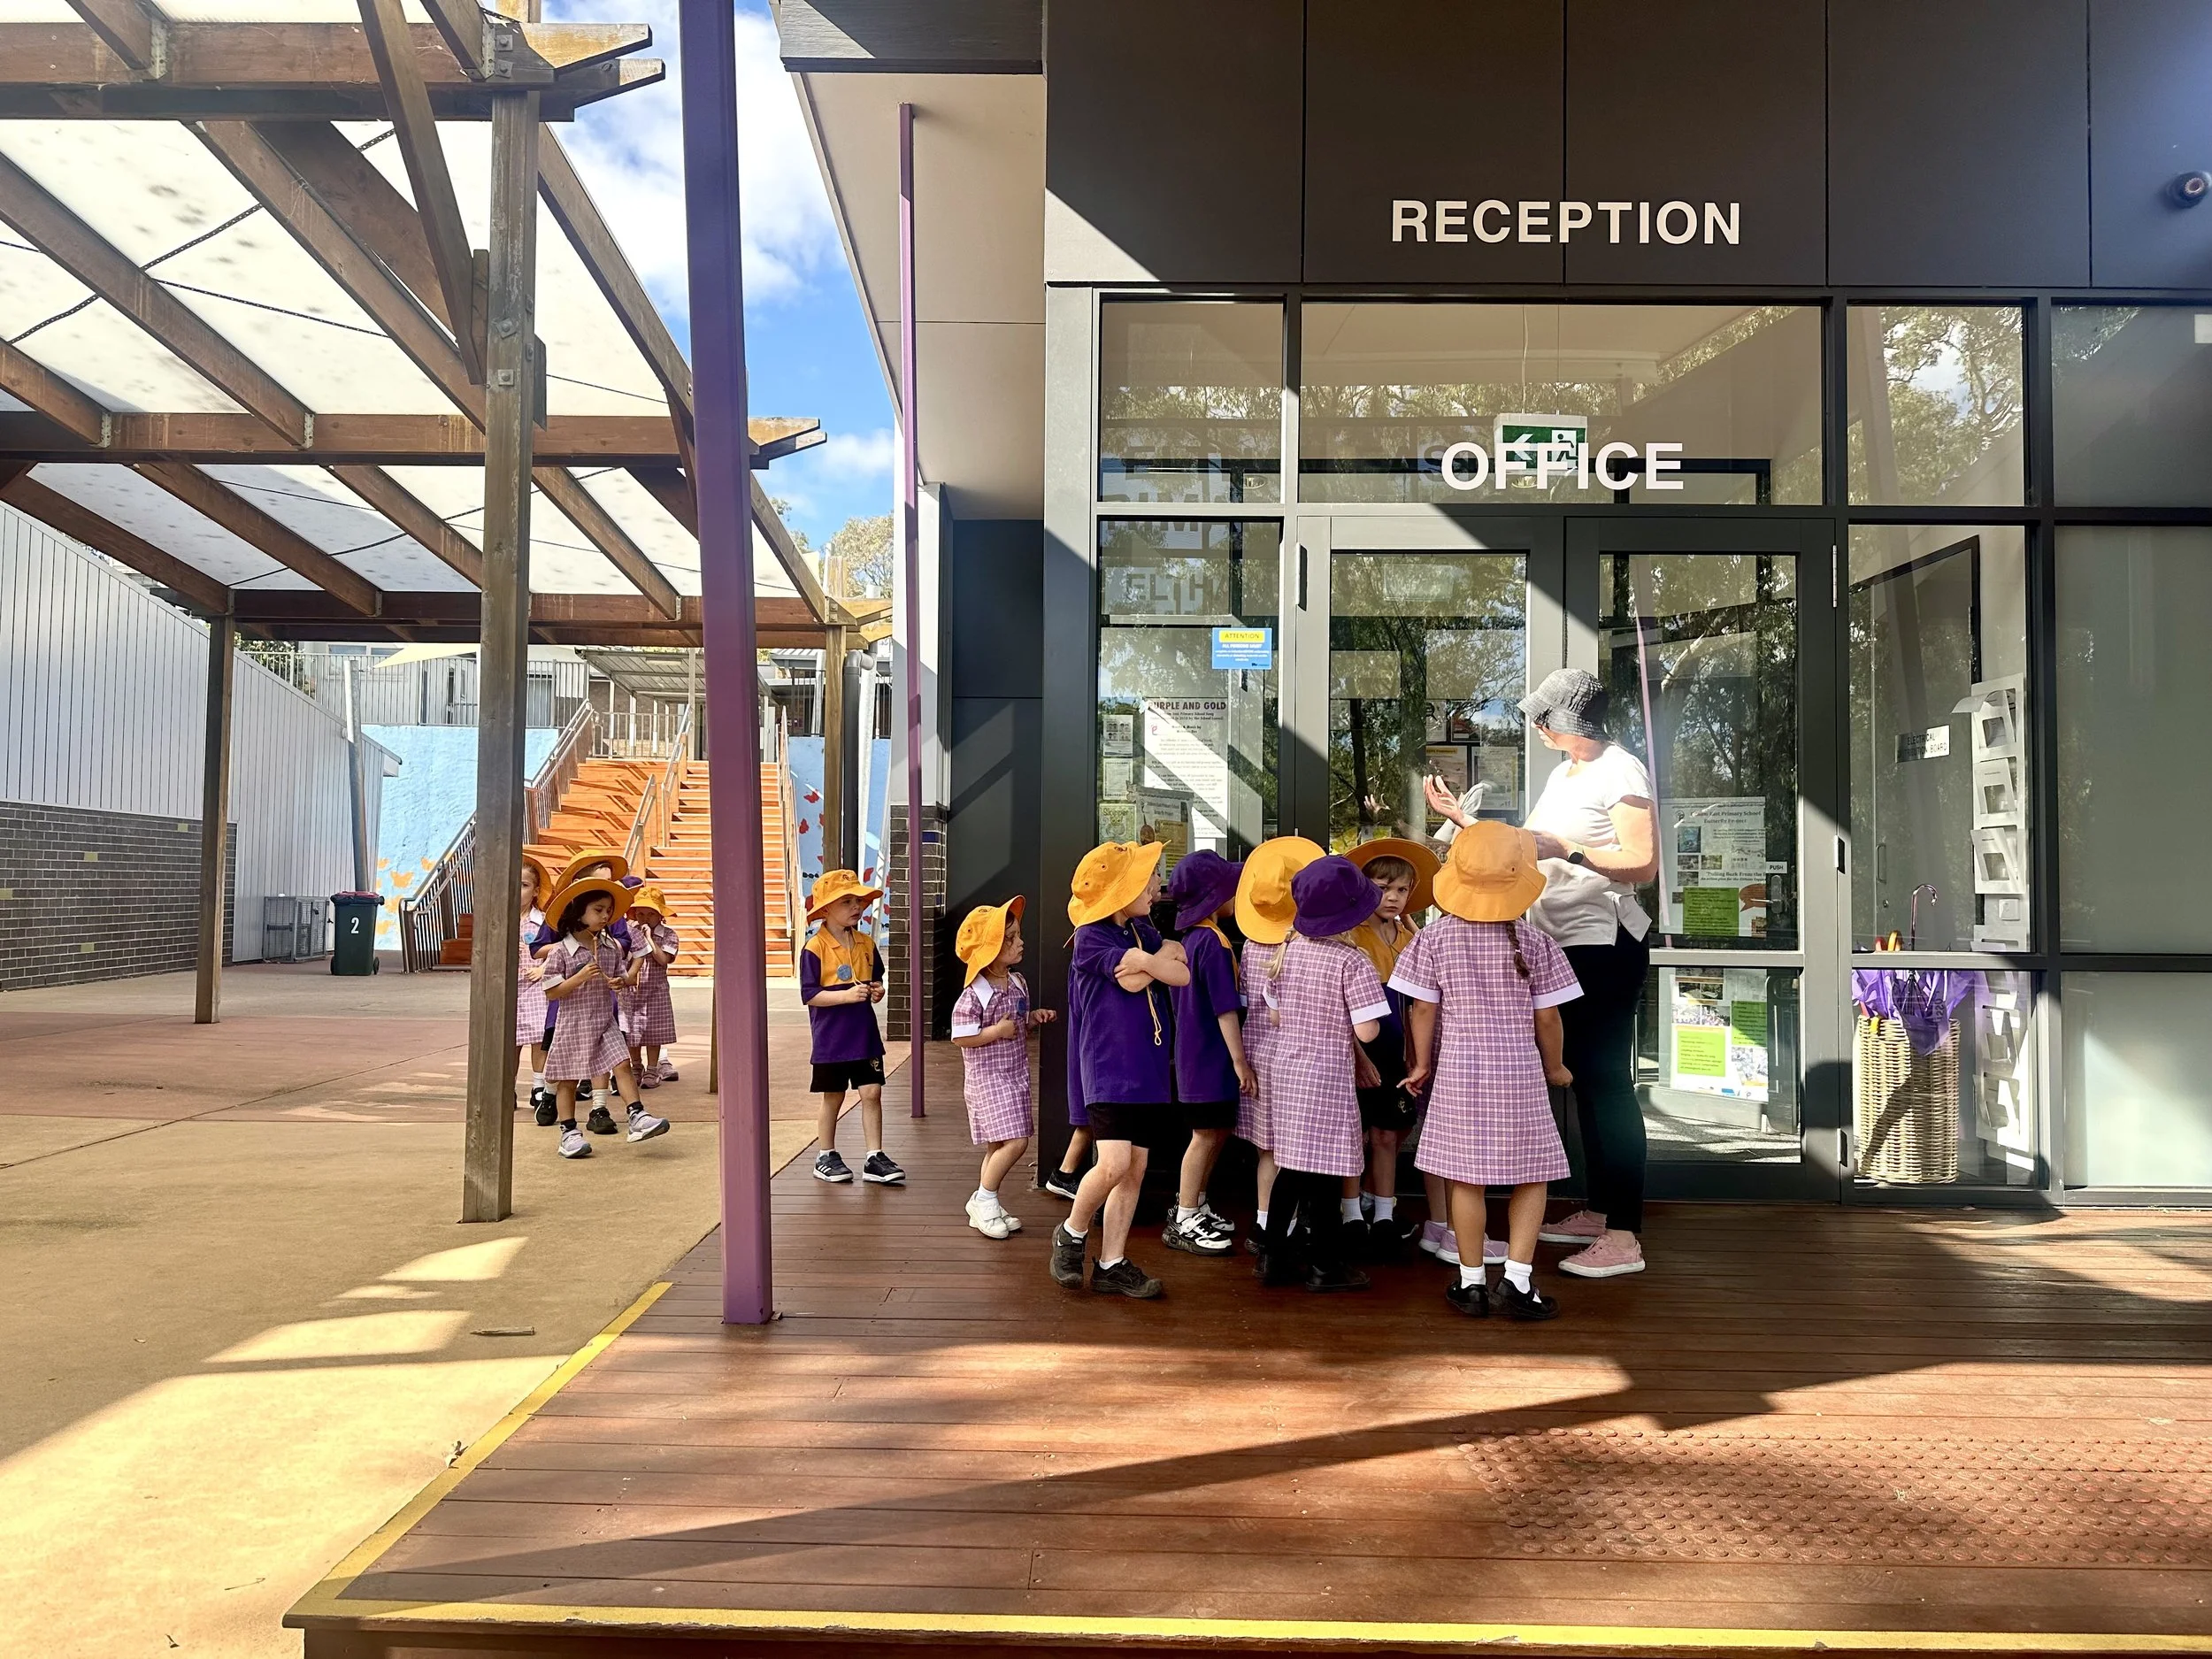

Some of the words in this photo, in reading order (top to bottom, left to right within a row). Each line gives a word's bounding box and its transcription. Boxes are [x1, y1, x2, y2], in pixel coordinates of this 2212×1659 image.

[1393, 199, 1740, 245] RECEPTION
[1440, 442, 1684, 491] OFFICE
[1182, 702, 1201, 710] AND
[1203, 702, 1226, 710] GOLD
[1907, 733, 1935, 746] ELECTRICAL
[1930, 741, 1947, 753] BOARD
[350, 917, 359, 934] 2
